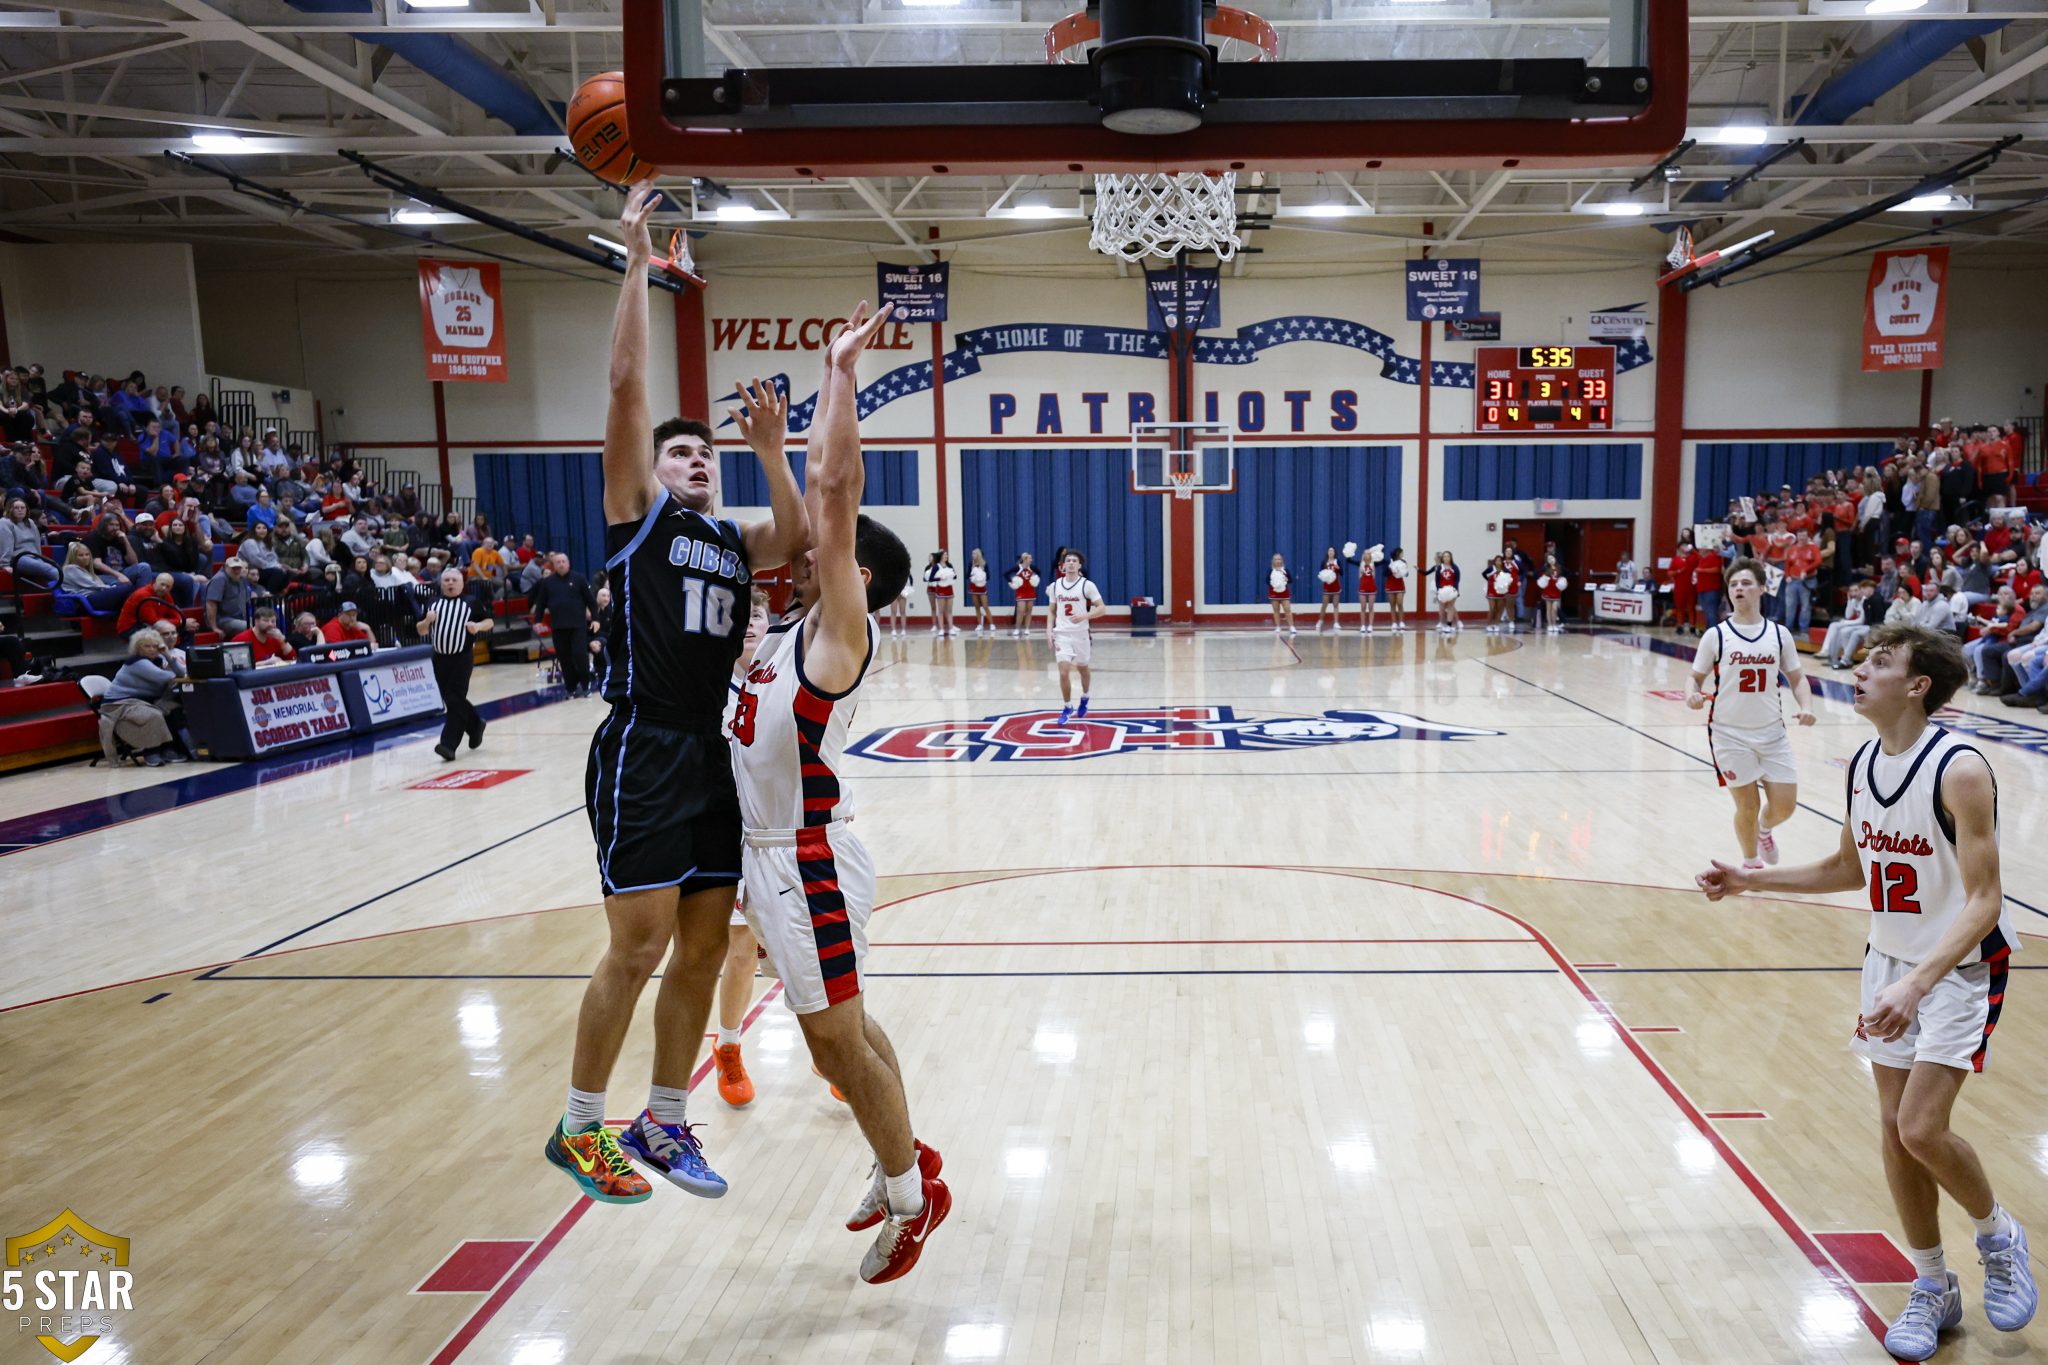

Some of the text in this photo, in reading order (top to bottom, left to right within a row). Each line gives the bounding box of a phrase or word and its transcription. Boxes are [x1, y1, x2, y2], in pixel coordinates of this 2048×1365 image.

[580, 121, 622, 162] ELITE
[885, 273, 943, 283] SWEET 16
[1407, 270, 1477, 281] SWEET 16
[1892, 280, 1922, 293] UNION
[444, 290, 482, 305] HORACE
[1901, 294, 1910, 310] 3
[456, 305, 472, 322] 25
[911, 309, 935, 317] 22-11
[1440, 306, 1464, 315] 24-6
[1889, 313, 1920, 325] COUNTY
[446, 325, 484, 336] MAYNARD
[996, 328, 1146, 353] HOME OF THE
[1870, 344, 1895, 355] TYLER
[432, 353, 459, 364] BRYAN
[1531, 348, 1572, 367] 5:35
[1487, 370, 1511, 379] HOME
[1578, 369, 1605, 378] GUEST
[1490, 381, 1513, 399] 31
[1541, 382, 1551, 397] 3
[1583, 380, 1606, 398] 33
[989, 390, 1358, 434] PATRIOTS
[1488, 407, 1498, 421] 0
[1508, 407, 1519, 421] 4
[1570, 407, 1582, 420] 4
[1600, 407, 1605, 420] 1
[682, 576, 736, 638] 10
[1065, 604, 1073, 616] 2
[1601, 597, 1643, 615] ESPN
[1729, 651, 1776, 666] Patriots
[392, 666, 425, 684] Reliant
[1739, 669, 1767, 693] 21
[251, 678, 332, 706] JIM HOUSTON
[273, 701, 318, 719] MEMORIAL
[254, 713, 347, 748] SCORER'S TABLE
[1870, 861, 1922, 914] 12
[641, 1116, 684, 1160] NIKE
